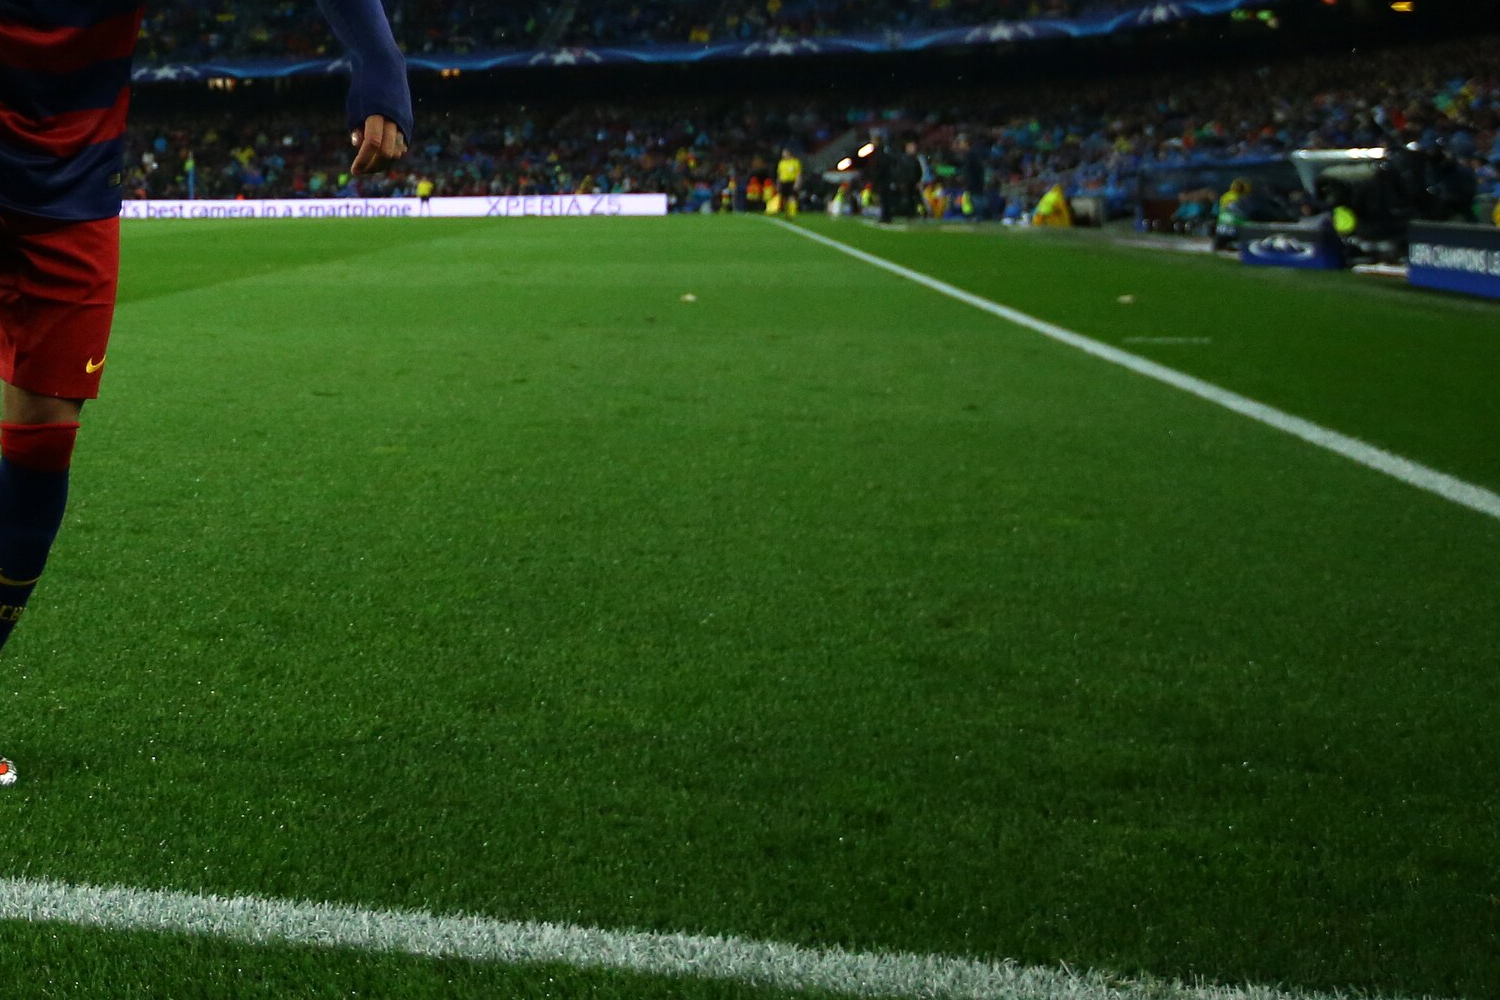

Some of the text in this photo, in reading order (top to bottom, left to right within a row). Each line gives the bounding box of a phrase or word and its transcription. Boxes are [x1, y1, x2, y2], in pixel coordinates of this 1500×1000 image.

[146, 201, 183, 218] best
[190, 205, 255, 218] camera
[262, 199, 277, 217] in
[282, 205, 293, 217] a
[299, 199, 412, 217] smartphone
[486, 194, 621, 216] XPERIA Z5
